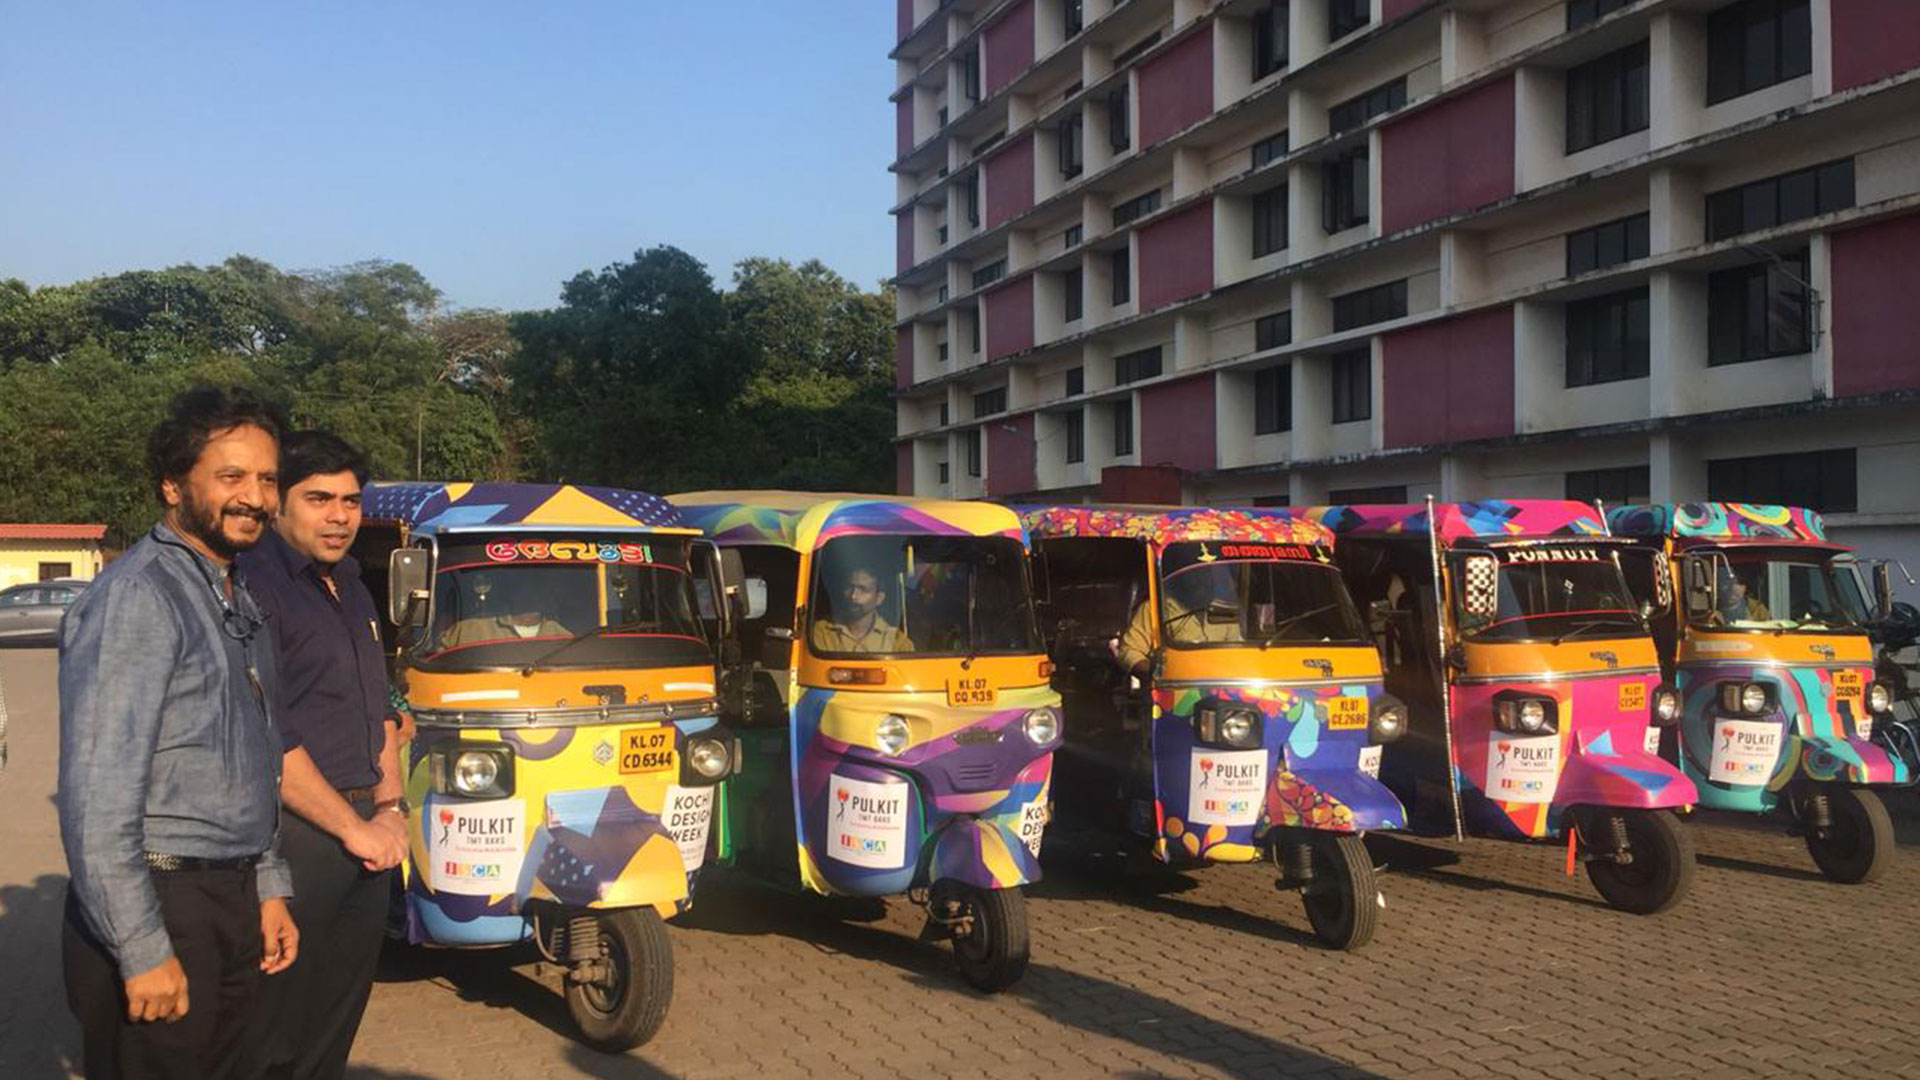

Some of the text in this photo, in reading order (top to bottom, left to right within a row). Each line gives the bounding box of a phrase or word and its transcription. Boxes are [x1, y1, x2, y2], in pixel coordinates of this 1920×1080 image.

[1737, 732, 1775, 745] PULKIT
[1513, 747, 1554, 760] PULKIT
[1216, 764, 1259, 778] PULKIT
[852, 796, 898, 814] PULKIT
[457, 817, 514, 834] PULKIT
